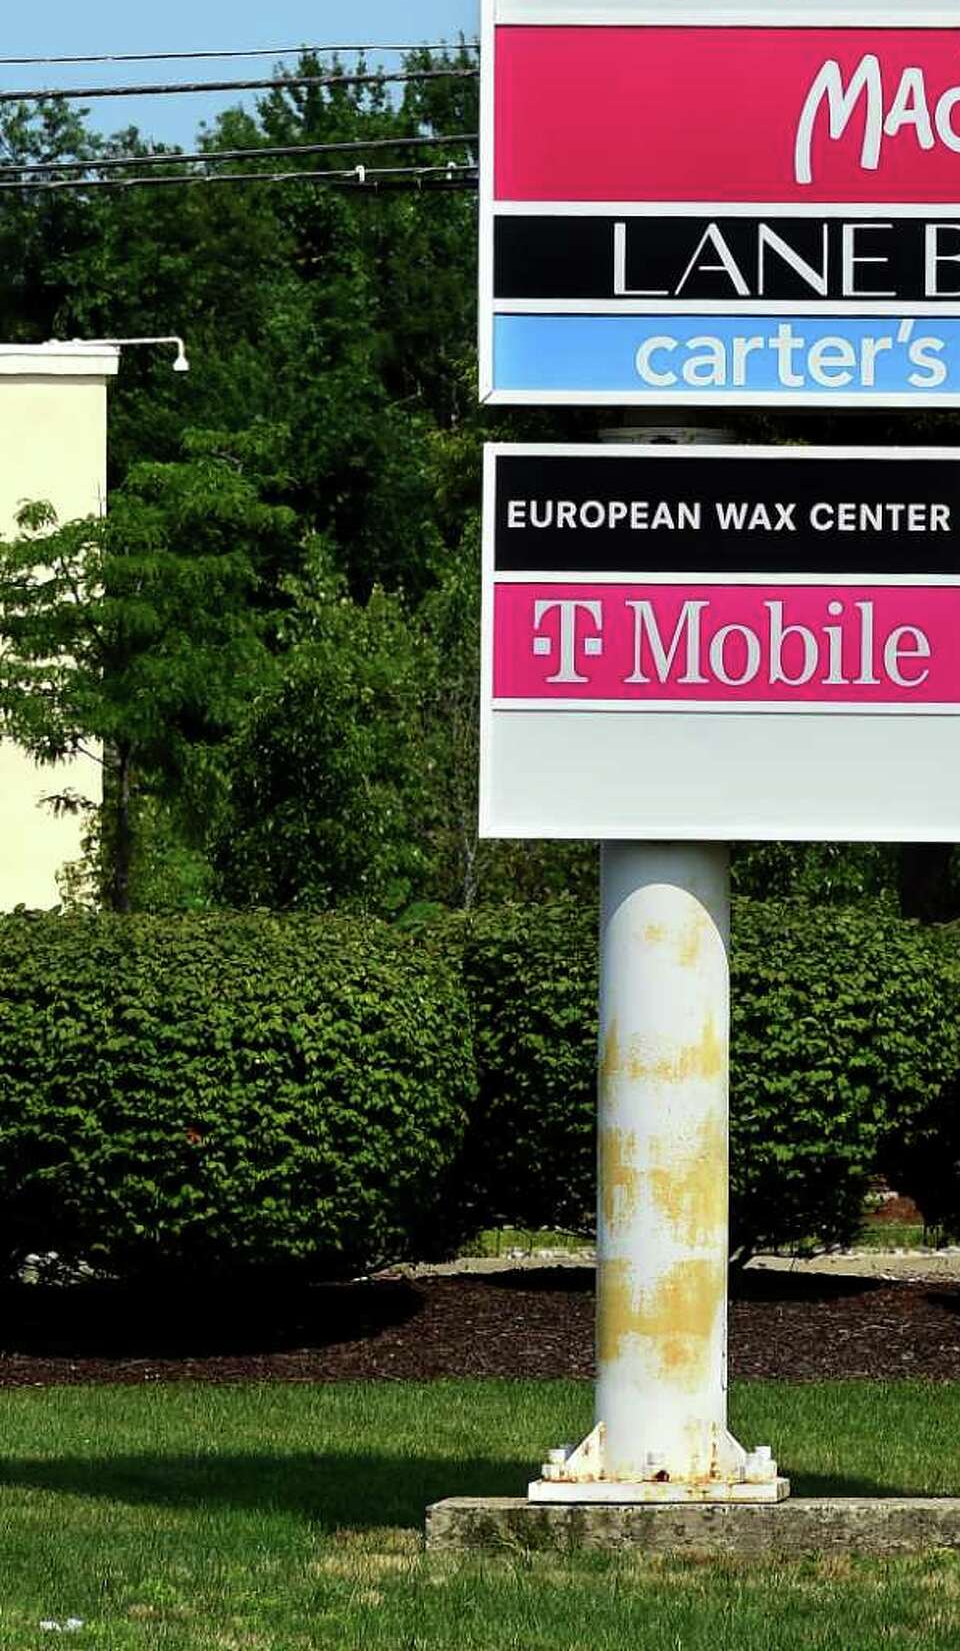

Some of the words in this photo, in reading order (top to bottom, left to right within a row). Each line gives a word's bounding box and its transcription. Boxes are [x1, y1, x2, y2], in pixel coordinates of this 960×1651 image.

[613, 222, 897, 296] LANE
[635, 318, 947, 388] carter's
[507, 500, 701, 530] EUROPEAN
[715, 502, 796, 531] WAX
[809, 502, 951, 532] CENTER
